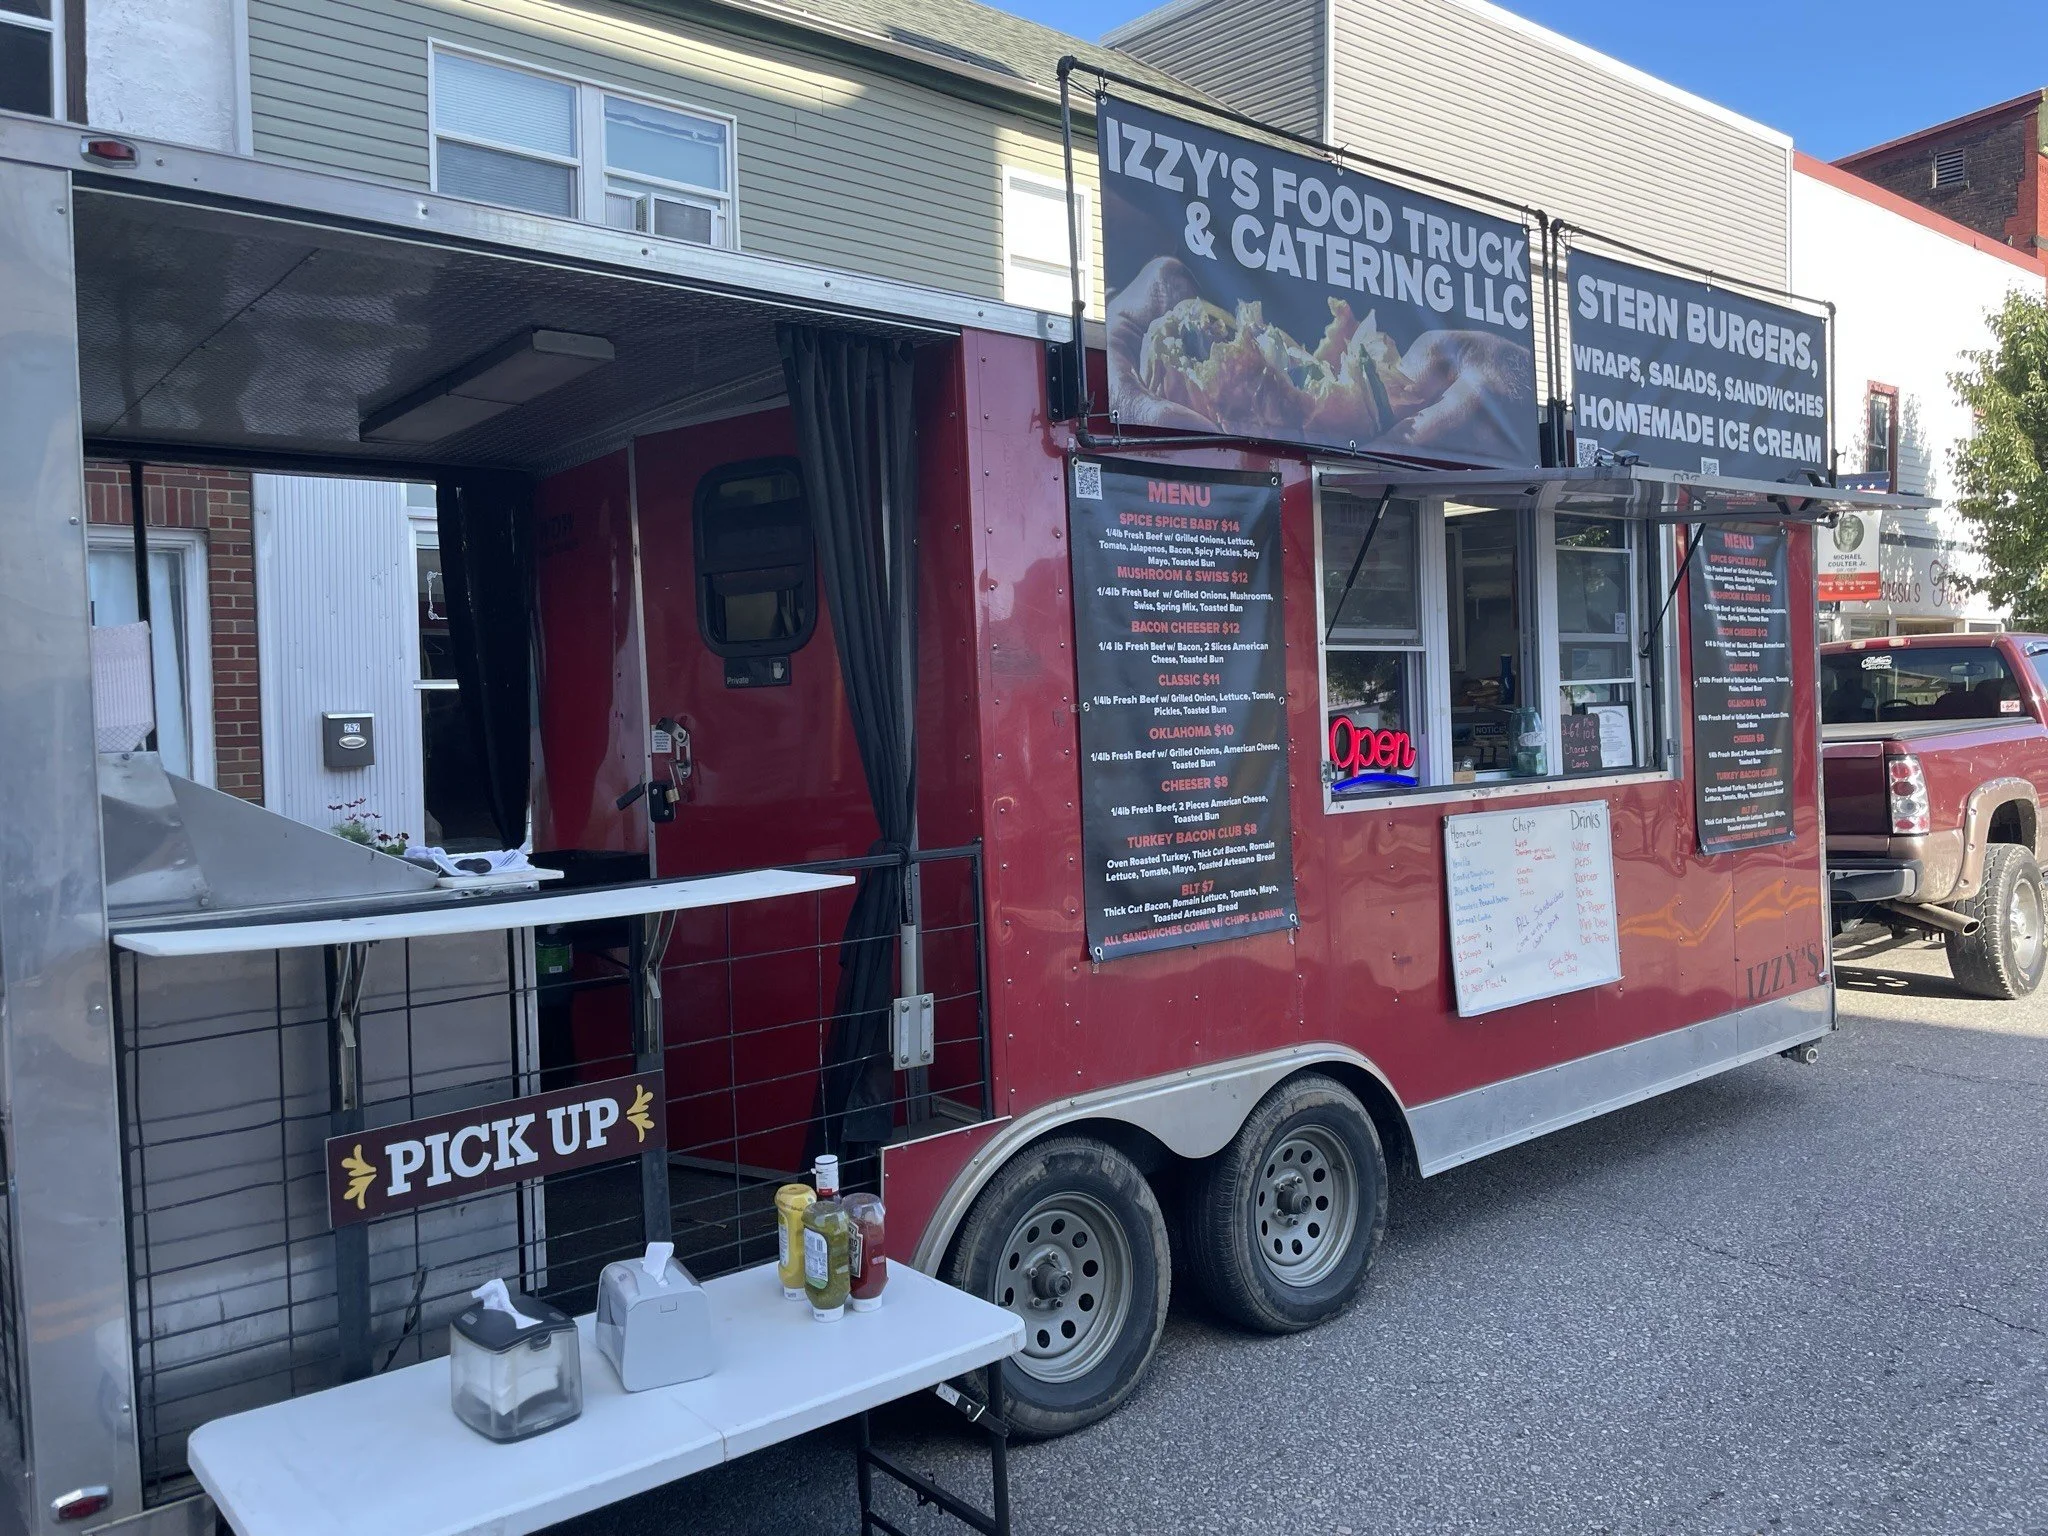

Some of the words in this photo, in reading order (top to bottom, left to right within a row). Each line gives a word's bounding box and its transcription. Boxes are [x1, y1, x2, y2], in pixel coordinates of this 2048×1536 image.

[1106, 116, 1260, 210] IZZY'S
[1273, 167, 1392, 244] FOOD
[1403, 206, 1526, 282] TRUCK
[1184, 201, 1217, 261] &
[1231, 214, 1453, 313] CATERING
[1464, 272, 1528, 330] LLC
[1578, 274, 1678, 340] STERN
[1687, 302, 1818, 379] BURGERS,
[1573, 344, 1645, 388] WRAPS,
[1650, 361, 1721, 402] SALADS,
[1724, 376, 1824, 418] SANDWICHES
[1580, 394, 1713, 446] HOMEMADE
[1719, 418, 1749, 452] ICE
[1753, 426, 1821, 463] CREAM
[1148, 481, 1210, 507] MENU
[1120, 513, 1152, 527] SPICE
[1156, 515, 1187, 529] SPICE
[1190, 517, 1218, 531] BABY
[1222, 519, 1239, 533] $14
[1124, 529, 1143, 539] Fresh
[1146, 531, 1163, 540] Beef
[1165, 532, 1173, 541] w/
[1175, 533, 1198, 542] Grilled
[1200, 534, 1226, 544] Onions,
[1228, 536, 1255, 546] Lettuce,
[1099, 541, 1128, 551] Tomato,
[1130, 542, 1167, 554] Jalapenos,
[1169, 545, 1193, 554] Bacon,
[1195, 546, 1213, 556] Spicy
[1215, 547, 1242, 557] Pickles,
[1243, 549, 1259, 559] Spicy
[1148, 556, 1170, 567] Mayo,
[1172, 558, 1199, 566] Toasted
[1201, 559, 1215, 567] Bun
[1118, 566, 1182, 580] MUSHROOM
[1186, 569, 1192, 581] &
[1195, 570, 1229, 582] SWISS
[1232, 571, 1248, 583] $12
[1122, 588, 1142, 597] Fresh
[1143, 589, 1159, 597] Beef
[1163, 589, 1172, 598] w/
[1174, 589, 1198, 598] Grilled
[1201, 590, 1228, 600] Onions,
[1230, 591, 1273, 601] Mushrooms,
[1134, 601, 1155, 611] Swiss,
[1156, 602, 1180, 612] Spring
[1182, 603, 1198, 611] Mix,
[1200, 603, 1228, 611] Toasted
[1230, 604, 1243, 612] Bun
[1132, 621, 1168, 633] BACON
[1171, 621, 1219, 634] CHEESER
[1222, 622, 1240, 634] $12
[1115, 642, 1122, 650] lb
[1126, 642, 1148, 650] Fresh
[1151, 642, 1165, 650] Beef
[1178, 643, 1202, 651] Bacon,
[727, 677, 749, 685] Private
[1159, 674, 1200, 686] CLASSIC
[1203, 674, 1220, 685] $11
[1113, 695, 1137, 704] Fresh
[1140, 695, 1158, 703] Beef
[1160, 694, 1170, 702] w/
[1171, 694, 1192, 702] Grilled
[1194, 693, 1218, 702] Onion,
[1220, 692, 1250, 701] Lettuce,
[1154, 707, 1182, 716] Pickles,
[1183, 706, 1209, 714] Toasted
[1211, 706, 1226, 714] Bun
[344, 723, 360, 733] 252
[1150, 725, 1211, 740] OKLAHOMA
[1214, 724, 1234, 737] $10
[1112, 750, 1133, 760] Fresh
[1135, 749, 1155, 758] Beef
[1157, 749, 1167, 757] w/
[1170, 747, 1192, 756] Grilled
[1194, 746, 1222, 756] Onions,
[1224, 744, 1255, 753] American
[1257, 742, 1280, 752] Cheese,
[1330, 717, 1416, 777] Open
[1161, 777, 1210, 792] CHEESER
[1214, 776, 1228, 788] $8
[1132, 804, 1153, 814] Fresh
[1156, 802, 1177, 813] Beef,
[1186, 800, 1209, 810] Pieces
[1211, 797, 1241, 808] American
[1243, 795, 1268, 806] Cheese,
[1513, 817, 1536, 832] Chips
[1570, 810, 1600, 830] Drinks
[1128, 832, 1173, 848] TURKEY
[1176, 828, 1215, 843] BACON
[1218, 825, 1241, 839] CLUB
[1244, 823, 1257, 836] $8
[1107, 857, 1128, 868] Oven
[1130, 854, 1160, 866] Roasted
[1162, 850, 1190, 863] Turkey,
[1192, 848, 1211, 858] Thick
[1213, 846, 1224, 856] Cut
[1225, 843, 1248, 855] Bacon,
[1249, 840, 1275, 852] Romain
[1106, 869, 1139, 882] Lettuce,
[1140, 865, 1170, 878] Tomato,
[1172, 862, 1196, 875] Mayo,
[1198, 859, 1222, 870] Toasted
[1224, 855, 1255, 867] Artesano
[1256, 852, 1275, 863] Bread
[1181, 882, 1198, 896] BLT
[1202, 880, 1214, 893] $7
[1104, 905, 1126, 917] Thick
[1128, 903, 1142, 913] Cut
[1144, 899, 1171, 912] Bacon,
[1172, 896, 1199, 907] Romain
[1201, 892, 1228, 904] Lettuce,
[1230, 888, 1258, 900] Tomato,
[1260, 885, 1278, 896] Mayo,
[1154, 910, 1182, 923] Toasted
[1184, 906, 1215, 919] Artesano
[1218, 902, 1238, 914] Bread
[1104, 934, 1120, 947] ALL
[1122, 924, 1182, 944] SANDWICHES
[1184, 919, 1210, 933] COME
[1212, 917, 1222, 929] W/
[1225, 913, 1249, 927] CHIPS
[1251, 912, 1257, 922] &
[1259, 908, 1284, 921] DRINK
[1747, 943, 1819, 1000] IZZY'S
[385, 1112, 538, 1197] PICK
[547, 1098, 619, 1156] UP
